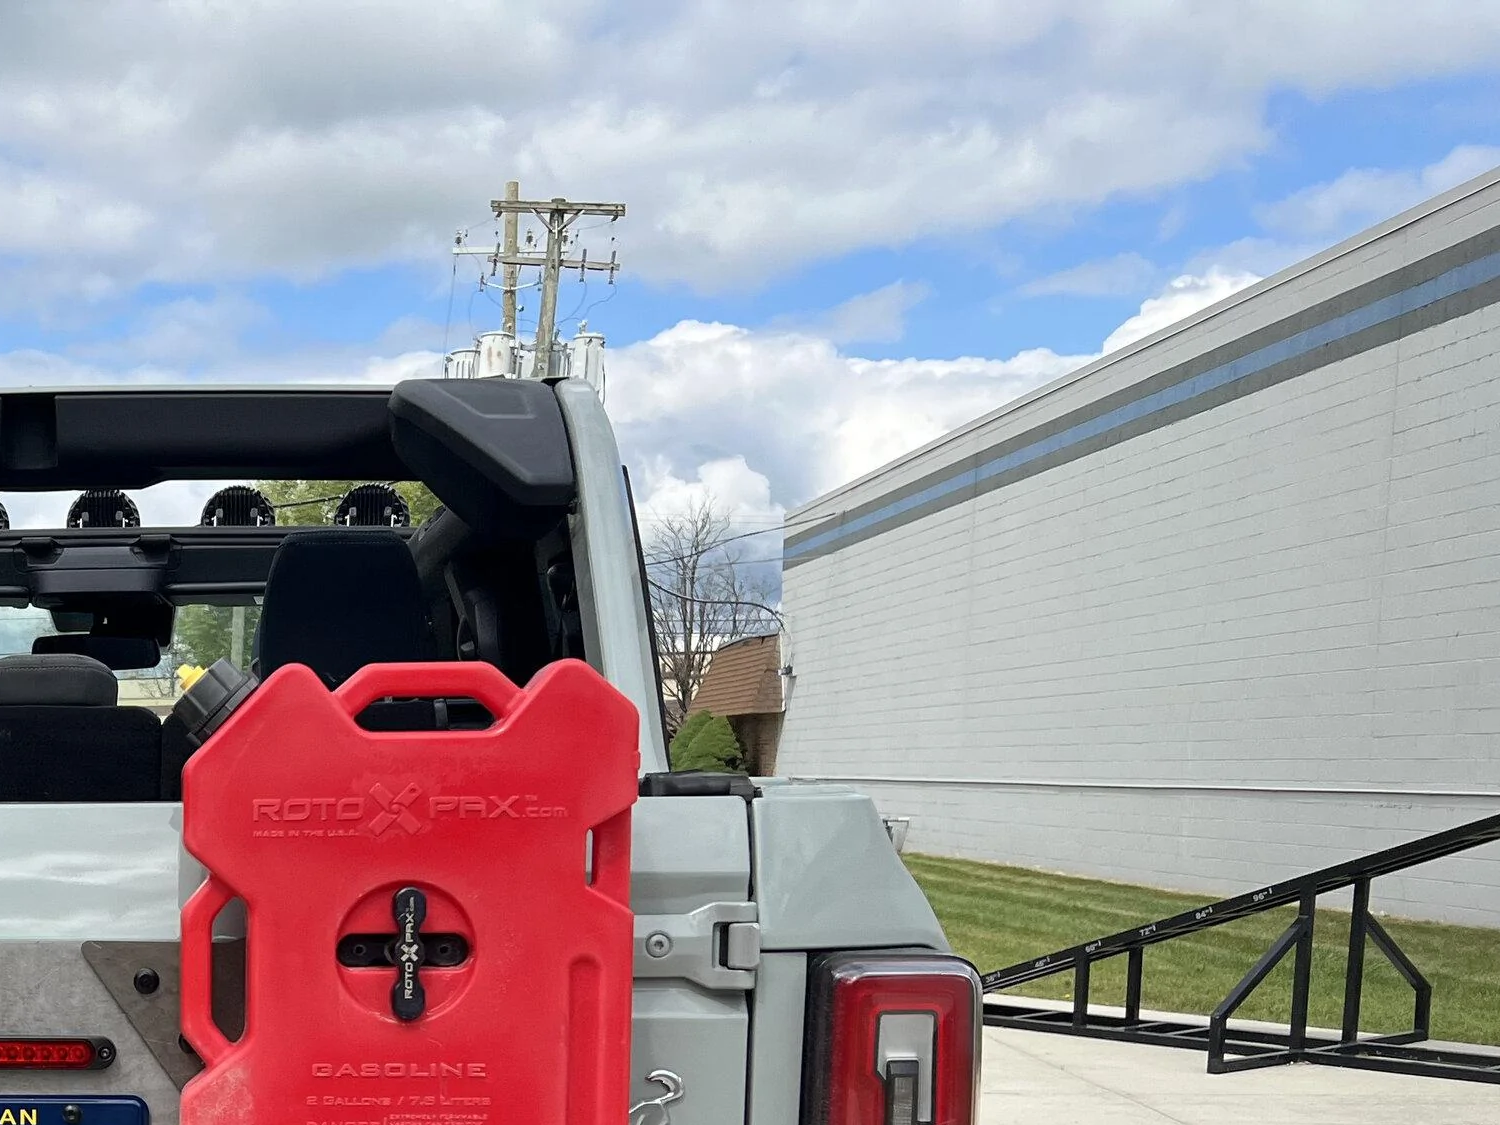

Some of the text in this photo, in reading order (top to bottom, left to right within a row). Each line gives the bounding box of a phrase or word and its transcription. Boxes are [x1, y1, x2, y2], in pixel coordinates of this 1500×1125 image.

[252, 798, 366, 821] ROTO
[252, 829, 285, 838] MADE
[288, 829, 300, 837] IN
[302, 829, 325, 837] THE
[404, 962, 414, 999] ROTO
[311, 1062, 487, 1078] GASOLINE
[306, 1096, 318, 1106] 2
[323, 1096, 392, 1106] GALLONS
